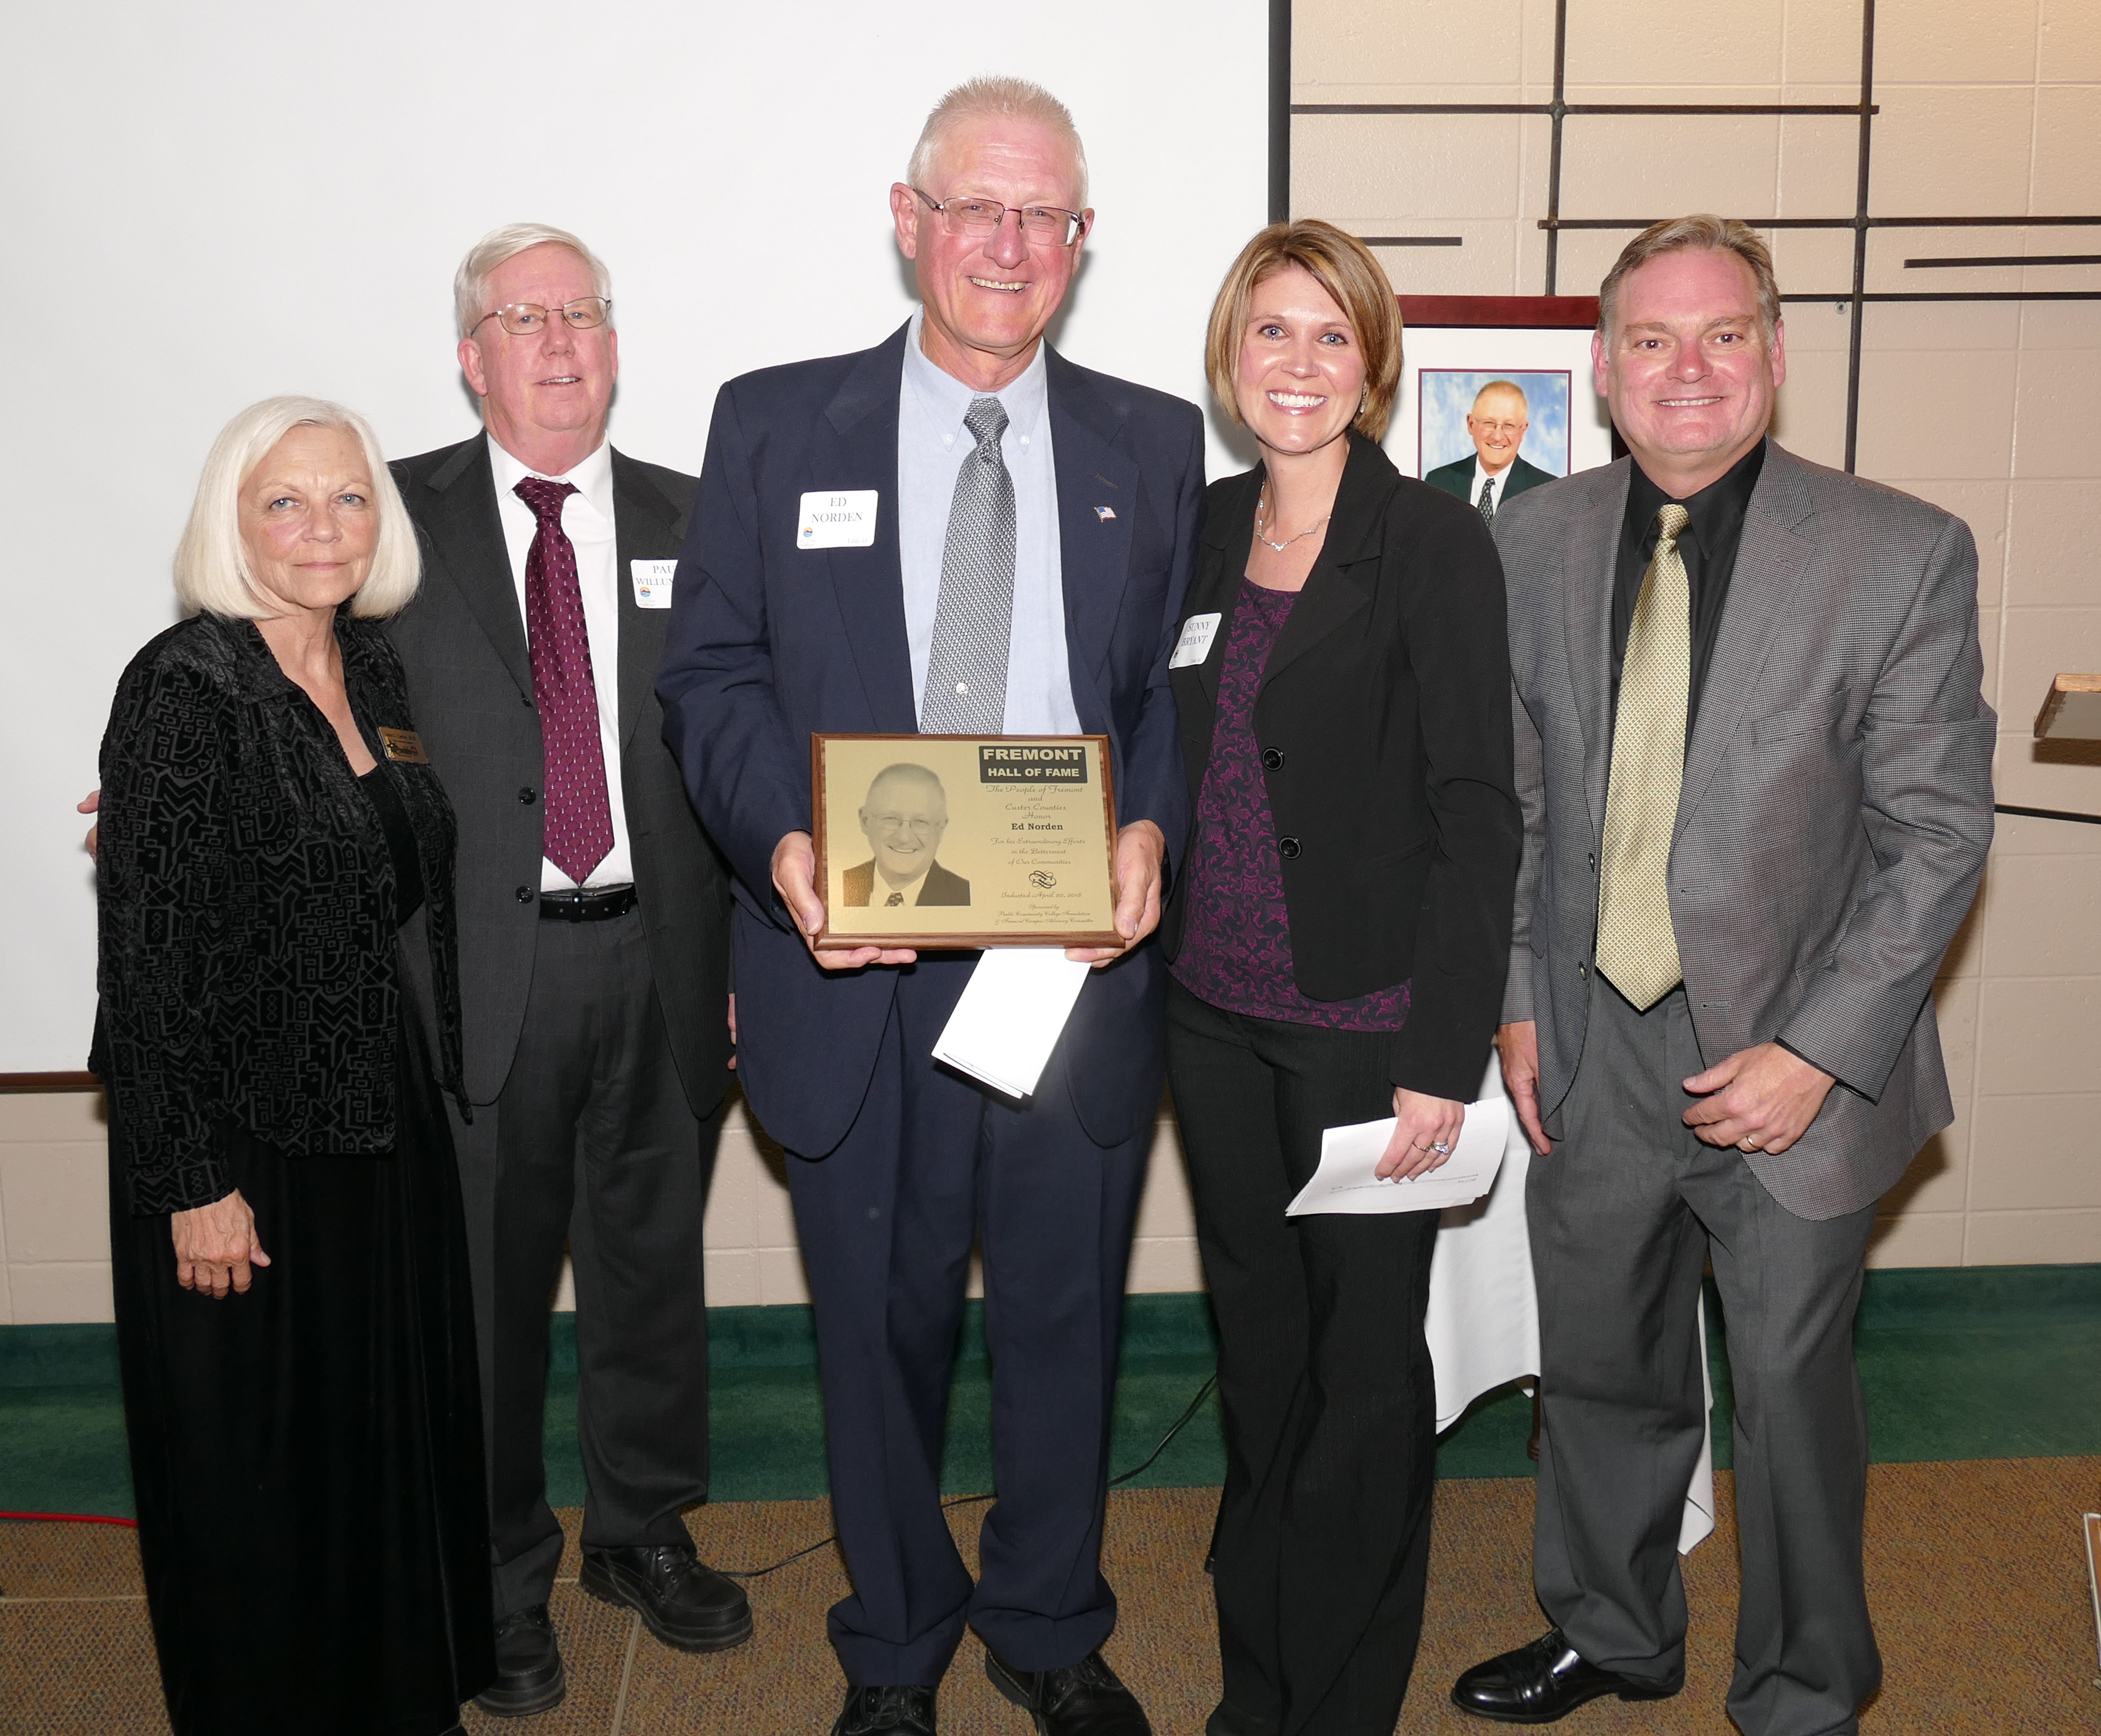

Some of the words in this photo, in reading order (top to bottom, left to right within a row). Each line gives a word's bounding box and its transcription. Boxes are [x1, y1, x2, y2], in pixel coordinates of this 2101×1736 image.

[830, 497, 847, 507] ED
[811, 512, 863, 523] NORDEN
[1187, 621, 1211, 632] SUNNY
[1181, 635, 1208, 646] BRYANT
[983, 749, 1082, 760] FREMONT
[988, 768, 1022, 777] HALL
[1025, 769, 1042, 777] OF
[1046, 769, 1079, 777] FAME
[1005, 785, 1035, 795] People
[1039, 785, 1047, 795] of
[1048, 785, 1083, 794] Fremont
[1022, 811, 1051, 819] Honor
[1017, 838, 1061, 846] Extraordinary
[1062, 838, 1085, 846] Efforts
[1008, 858, 1016, 867] of
[1032, 891, 1055, 899] April
